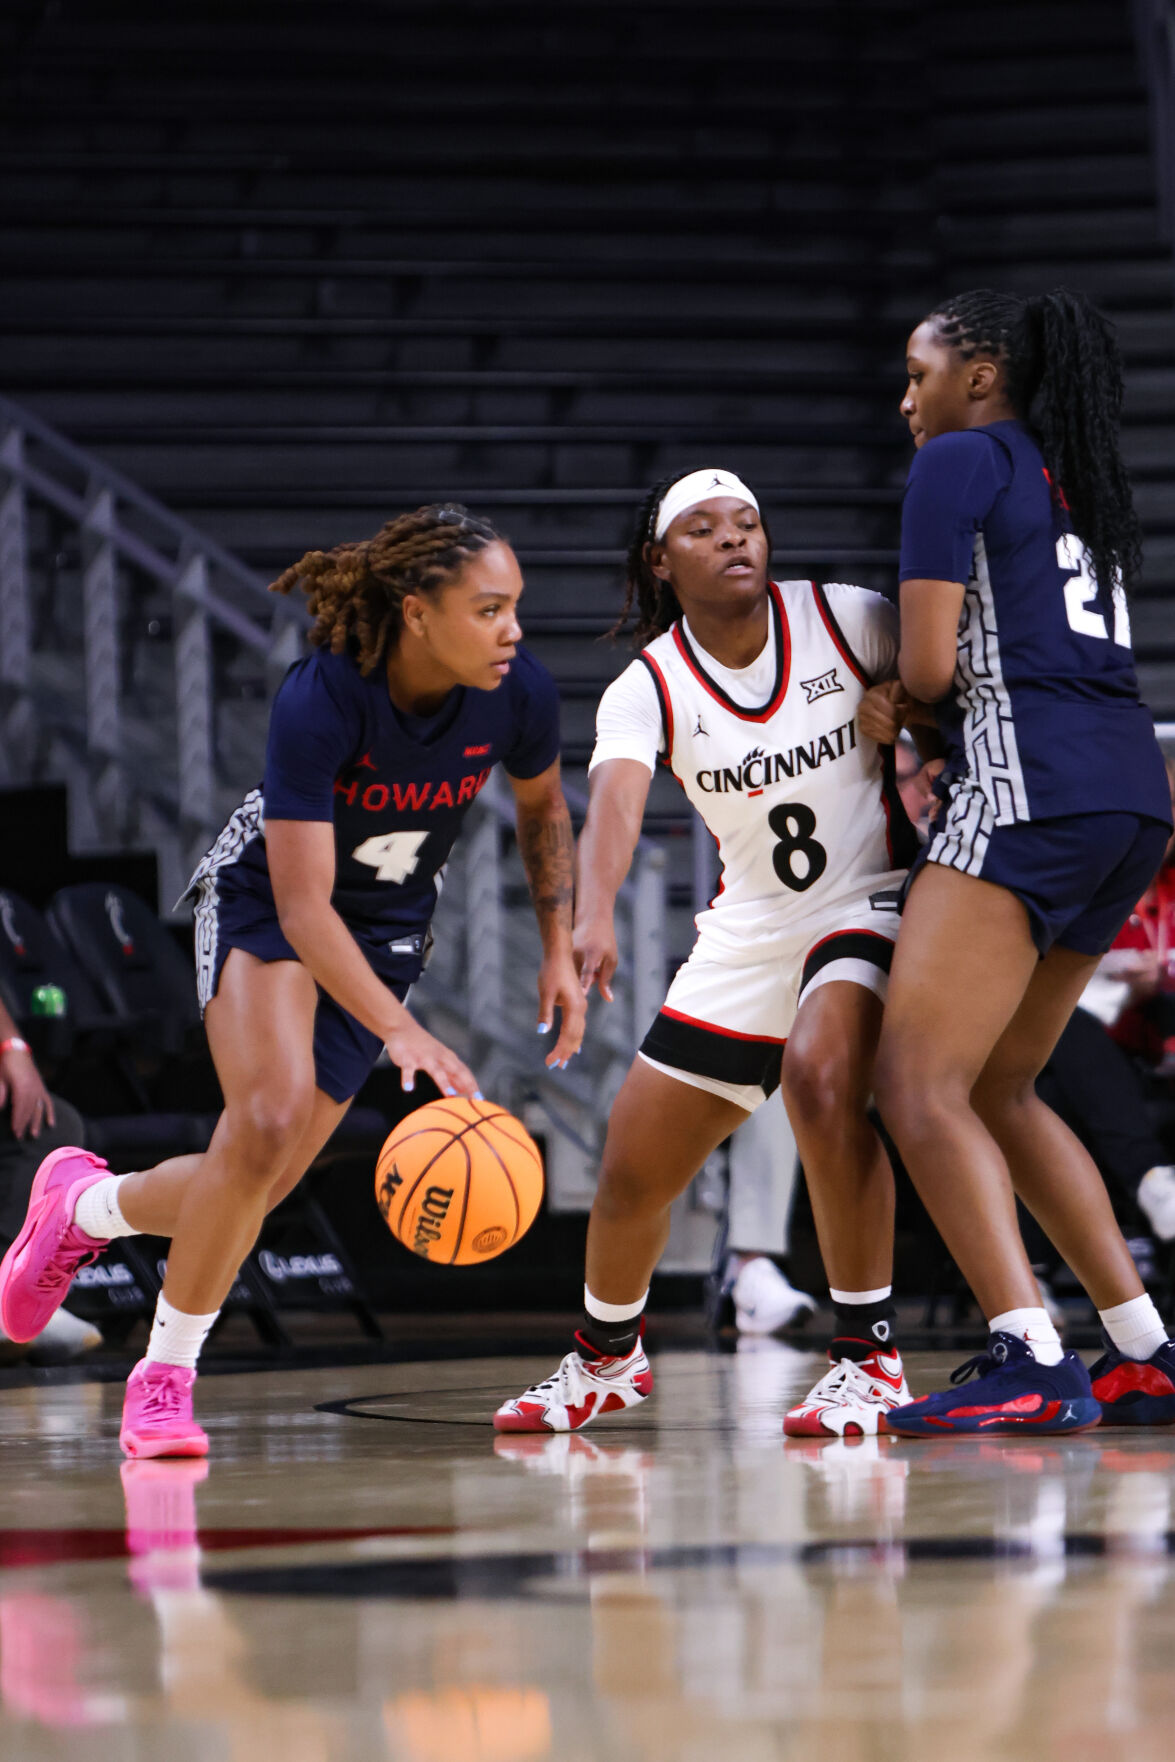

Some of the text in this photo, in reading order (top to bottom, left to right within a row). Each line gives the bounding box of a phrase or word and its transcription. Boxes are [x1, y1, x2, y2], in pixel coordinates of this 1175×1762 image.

[696, 717, 857, 790] CINCINNATI
[351, 830, 431, 886] 4
[767, 802, 828, 893] 8
